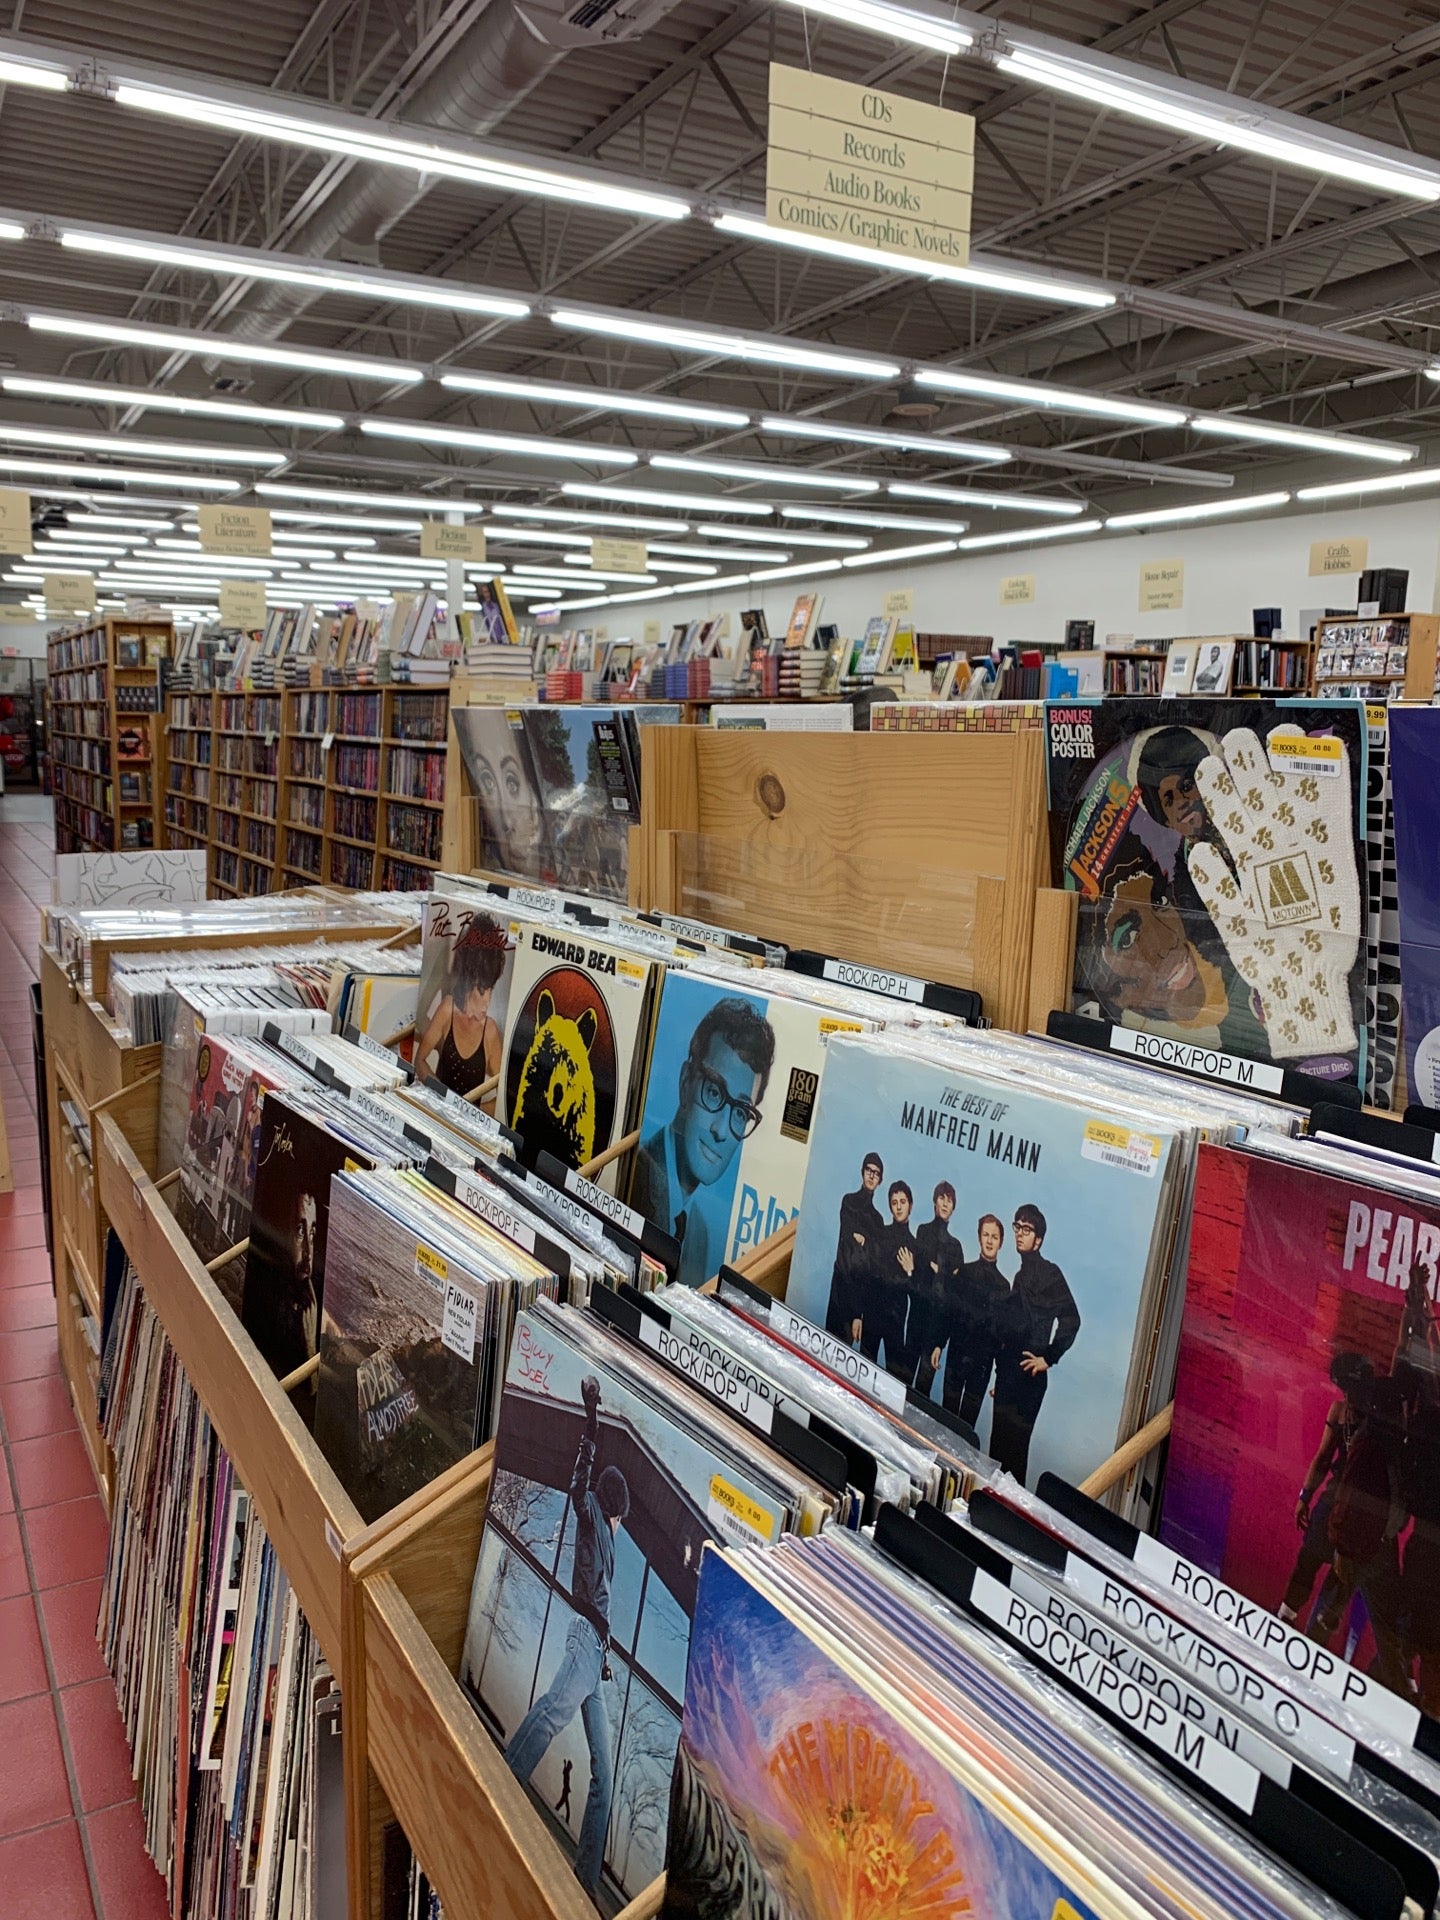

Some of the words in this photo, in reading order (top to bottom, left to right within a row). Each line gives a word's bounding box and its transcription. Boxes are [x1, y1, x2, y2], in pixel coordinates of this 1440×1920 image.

[861, 93, 893, 123] CDs
[843, 132, 906, 169] Records
[823, 169, 870, 200] Audio
[873, 180, 921, 212] Books
[913, 227, 960, 257] Novels
[1323, 559, 1351, 571] Hobbies
[1327, 545, 1350, 556] Crafts
[1144, 570, 1160, 582] Home
[1161, 569, 1179, 581] Repair
[1050, 709, 1092, 724] BONUS!
[1051, 723, 1094, 742] COLOR
[1051, 742, 1095, 759] POSTER
[1063, 815, 1088, 868] MICHAEL
[1082, 768, 1111, 823] JACKSON
[1091, 860, 1104, 879] 14
[1101, 813, 1127, 861] GREATEST
[1126, 789, 1140, 815] HITS
[1069, 799, 1121, 902] JACKSON
[515, 890, 549, 910] ROCK/POP
[532, 932, 585, 964] EDWARD
[587, 948, 618, 976] BEA
[837, 965, 896, 992] ROCK/POP
[898, 980, 908, 996] H
[1134, 1034, 1232, 1076] ROCK/POP
[1237, 1063, 1254, 1084] M
[1331, 1062, 1350, 1073] DISC
[788, 1089, 812, 1104] gram
[790, 1070, 816, 1094] 180
[939, 1086, 963, 1109] THE
[961, 1093, 993, 1118] BEST
[990, 1102, 1010, 1122] OF
[901, 1100, 980, 1152] MANFRED
[986, 1128, 1042, 1173] MANN
[466, 1187, 511, 1232] ROCK/POP
[513, 1221, 520, 1237] F
[576, 1177, 622, 1218] ROCK/POP
[622, 1211, 632, 1228] H
[1343, 1199, 1440, 1304] PEAR
[447, 1286, 474, 1316] FIDLAR
[658, 1330, 738, 1400] ROCK/POP
[740, 1391, 750, 1414] J
[789, 1317, 870, 1382] ROCK/POP
[872, 1373, 881, 1397] L
[1170, 1560, 1334, 1682] ROCK/POP
[1341, 1669, 1368, 1702] P
[1102, 1581, 1264, 1706] ROCK/POP
[1274, 1699, 1300, 1737] O
[1006, 1598, 1167, 1734] ROCK/POP
[1175, 1735, 1207, 1770] M
[1216, 1717, 1240, 1752] N
[822, 1717, 936, 1836] MOODY
